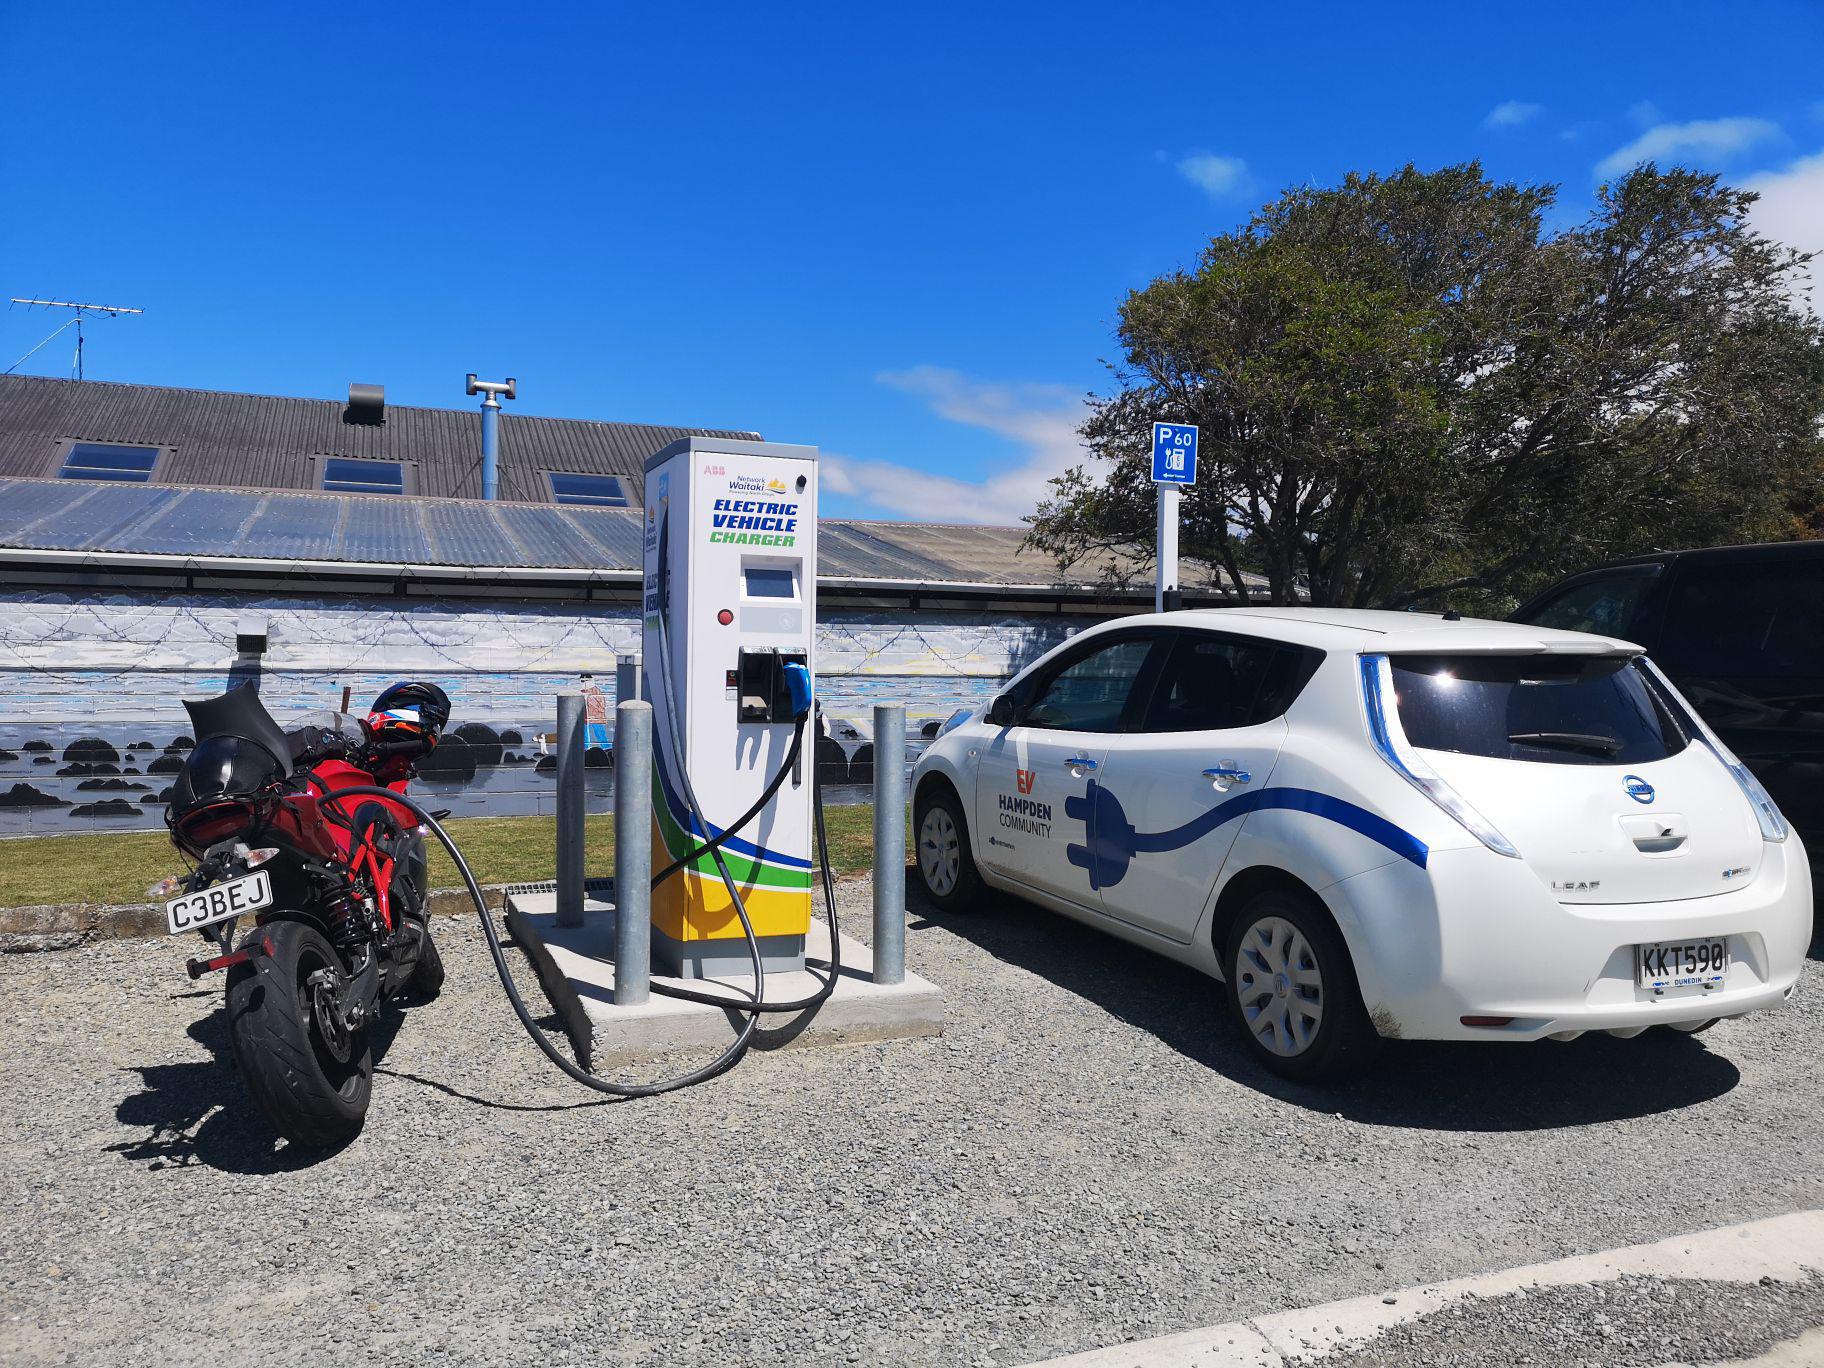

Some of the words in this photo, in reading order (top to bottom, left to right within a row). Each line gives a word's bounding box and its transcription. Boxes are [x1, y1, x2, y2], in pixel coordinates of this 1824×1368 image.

[1160, 427, 1173, 445] P
[1174, 433, 1192, 447] 60
[704, 465, 726, 476] ABB
[737, 475, 766, 484] Network
[729, 481, 765, 492] Waitaki
[713, 498, 799, 516] ELECTRIC
[712, 514, 798, 532] VEHICLE
[710, 531, 796, 547] CHARGER
[1016, 769, 1036, 795] EV
[999, 794, 1052, 821] HAMPDEN
[1000, 813, 1052, 839] COMMUNITY
[1551, 880, 1600, 893] LEAF
[172, 877, 265, 928] C3BEJ
[1643, 943, 1723, 978] KKT590
[1674, 977, 1702, 986] DUNEDIN
